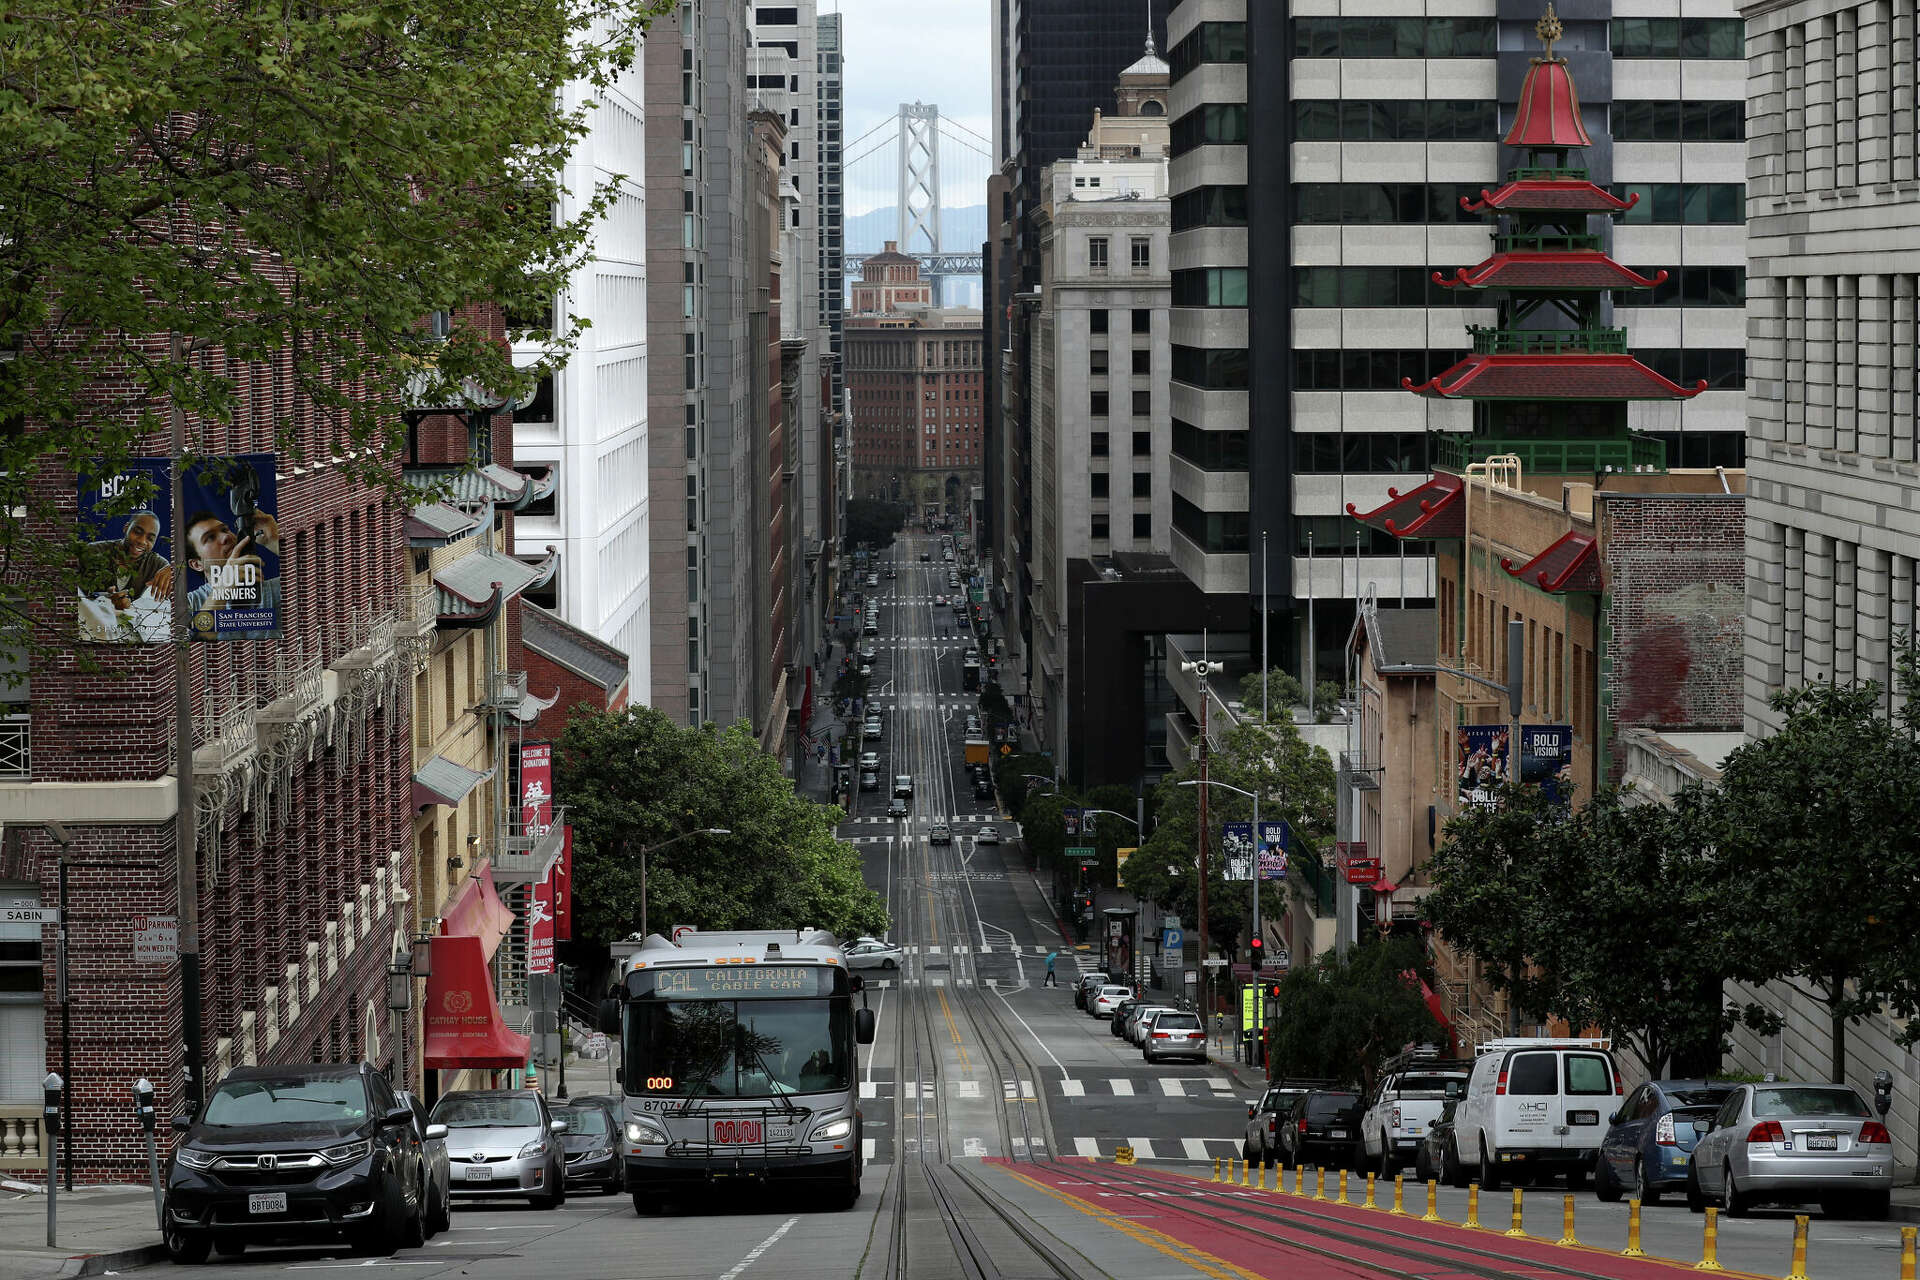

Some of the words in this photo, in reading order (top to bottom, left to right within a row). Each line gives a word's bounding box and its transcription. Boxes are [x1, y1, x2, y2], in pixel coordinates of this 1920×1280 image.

[210, 564, 256, 586] BOLD
[211, 588, 257, 600] ANSWERS
[1533, 735, 1559, 746] BOLD
[522, 749, 543, 758] WELCOME
[1534, 747, 1558, 757] VISION
[523, 759, 550, 768] CHINATOWN
[1266, 835, 1280, 843] NOW
[1231, 859, 1246, 867] BOLD
[7, 911, 42, 920] SABIN
[134, 918, 146, 930] NO
[149, 921, 177, 929] PARKING
[138, 933, 143, 941] 2
[158, 933, 163, 941] 6
[1166, 932, 1180, 947] P
[658, 972, 698, 992] CAL
[706, 969, 808, 981] CALIFORNIA
[711, 981, 762, 991] CABLE
[770, 980, 802, 989] CAR
[429, 1016, 459, 1024] CATHAY
[461, 1016, 488, 1024] HOUSE
[647, 1077, 673, 1089] 000
[644, 1101, 675, 1111] 8707
[251, 1200, 285, 1212] 8BTD084
